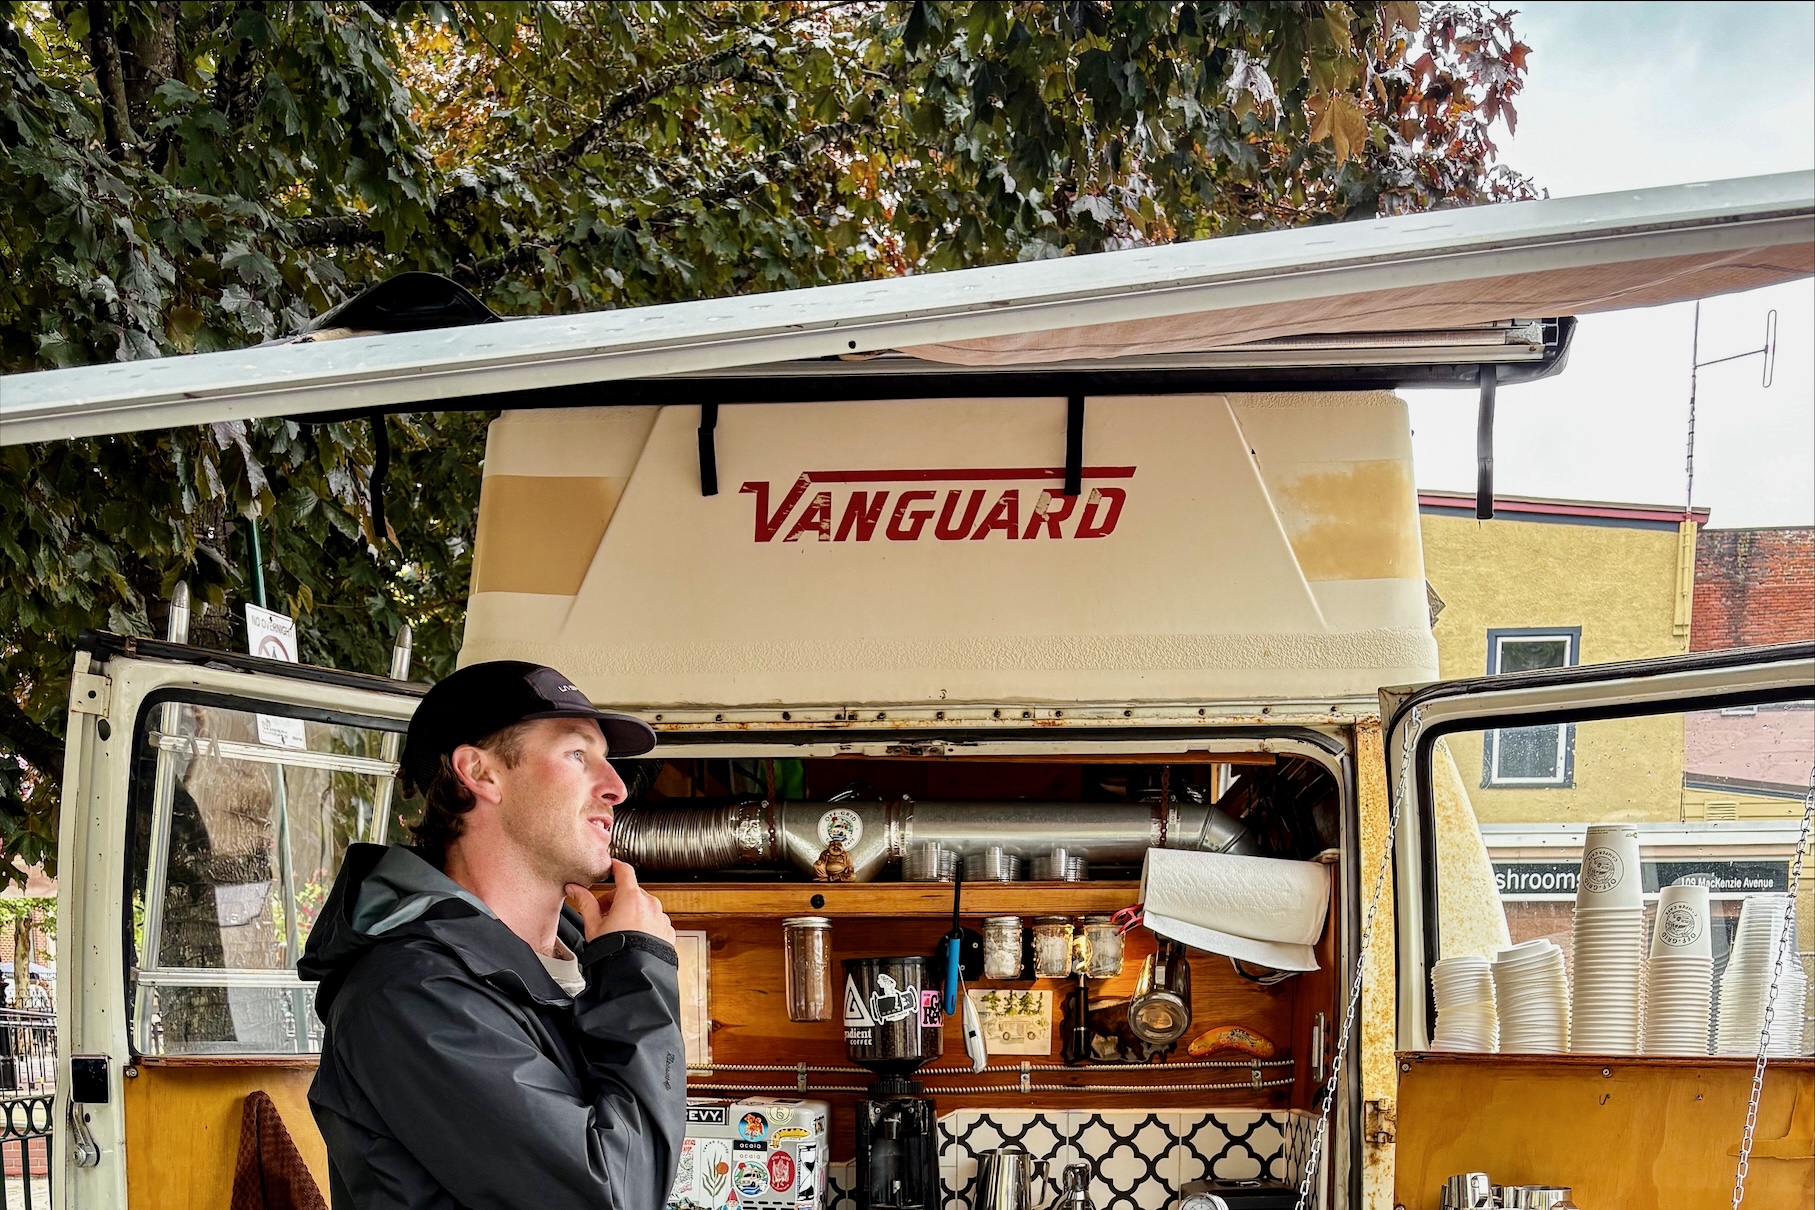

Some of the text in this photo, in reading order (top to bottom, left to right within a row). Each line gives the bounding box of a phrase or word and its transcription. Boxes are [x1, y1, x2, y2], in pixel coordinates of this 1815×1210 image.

[739, 467, 1133, 543] VANGUARD
[251, 615, 260, 627] NO
[825, 811, 857, 822] OFF-GRID
[1584, 877, 1617, 891] OFF-GRID
[1699, 877, 1741, 889] MacKenzie
[1744, 878, 1774, 888] Avenue
[1661, 931, 1697, 944] OFF-GRID
[686, 1110, 722, 1121] EVY.
